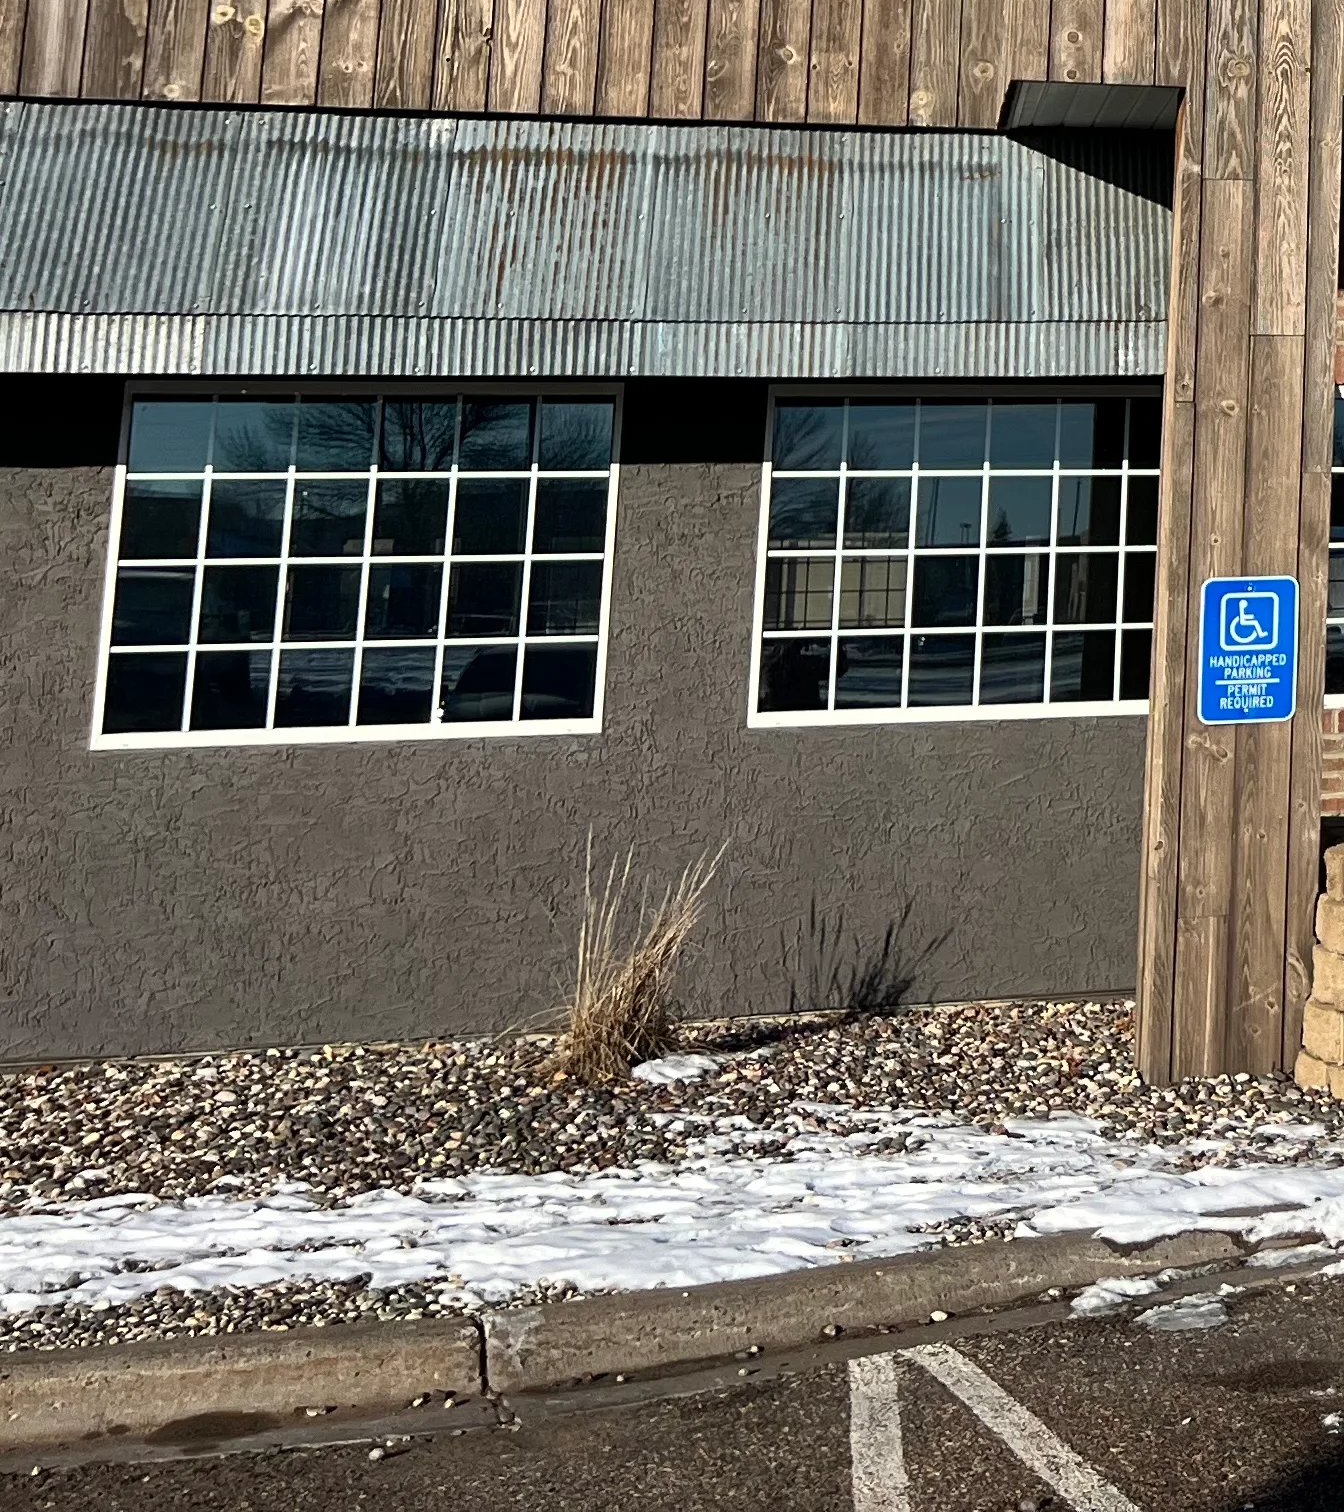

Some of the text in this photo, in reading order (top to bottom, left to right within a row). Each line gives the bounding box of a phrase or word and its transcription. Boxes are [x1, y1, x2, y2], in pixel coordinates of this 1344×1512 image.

[1209, 653, 1287, 668] HANDICAPPED
[1224, 666, 1272, 679] PARKING
[1227, 683, 1268, 697] PERMIT
[1219, 695, 1274, 710] REQUIRED
